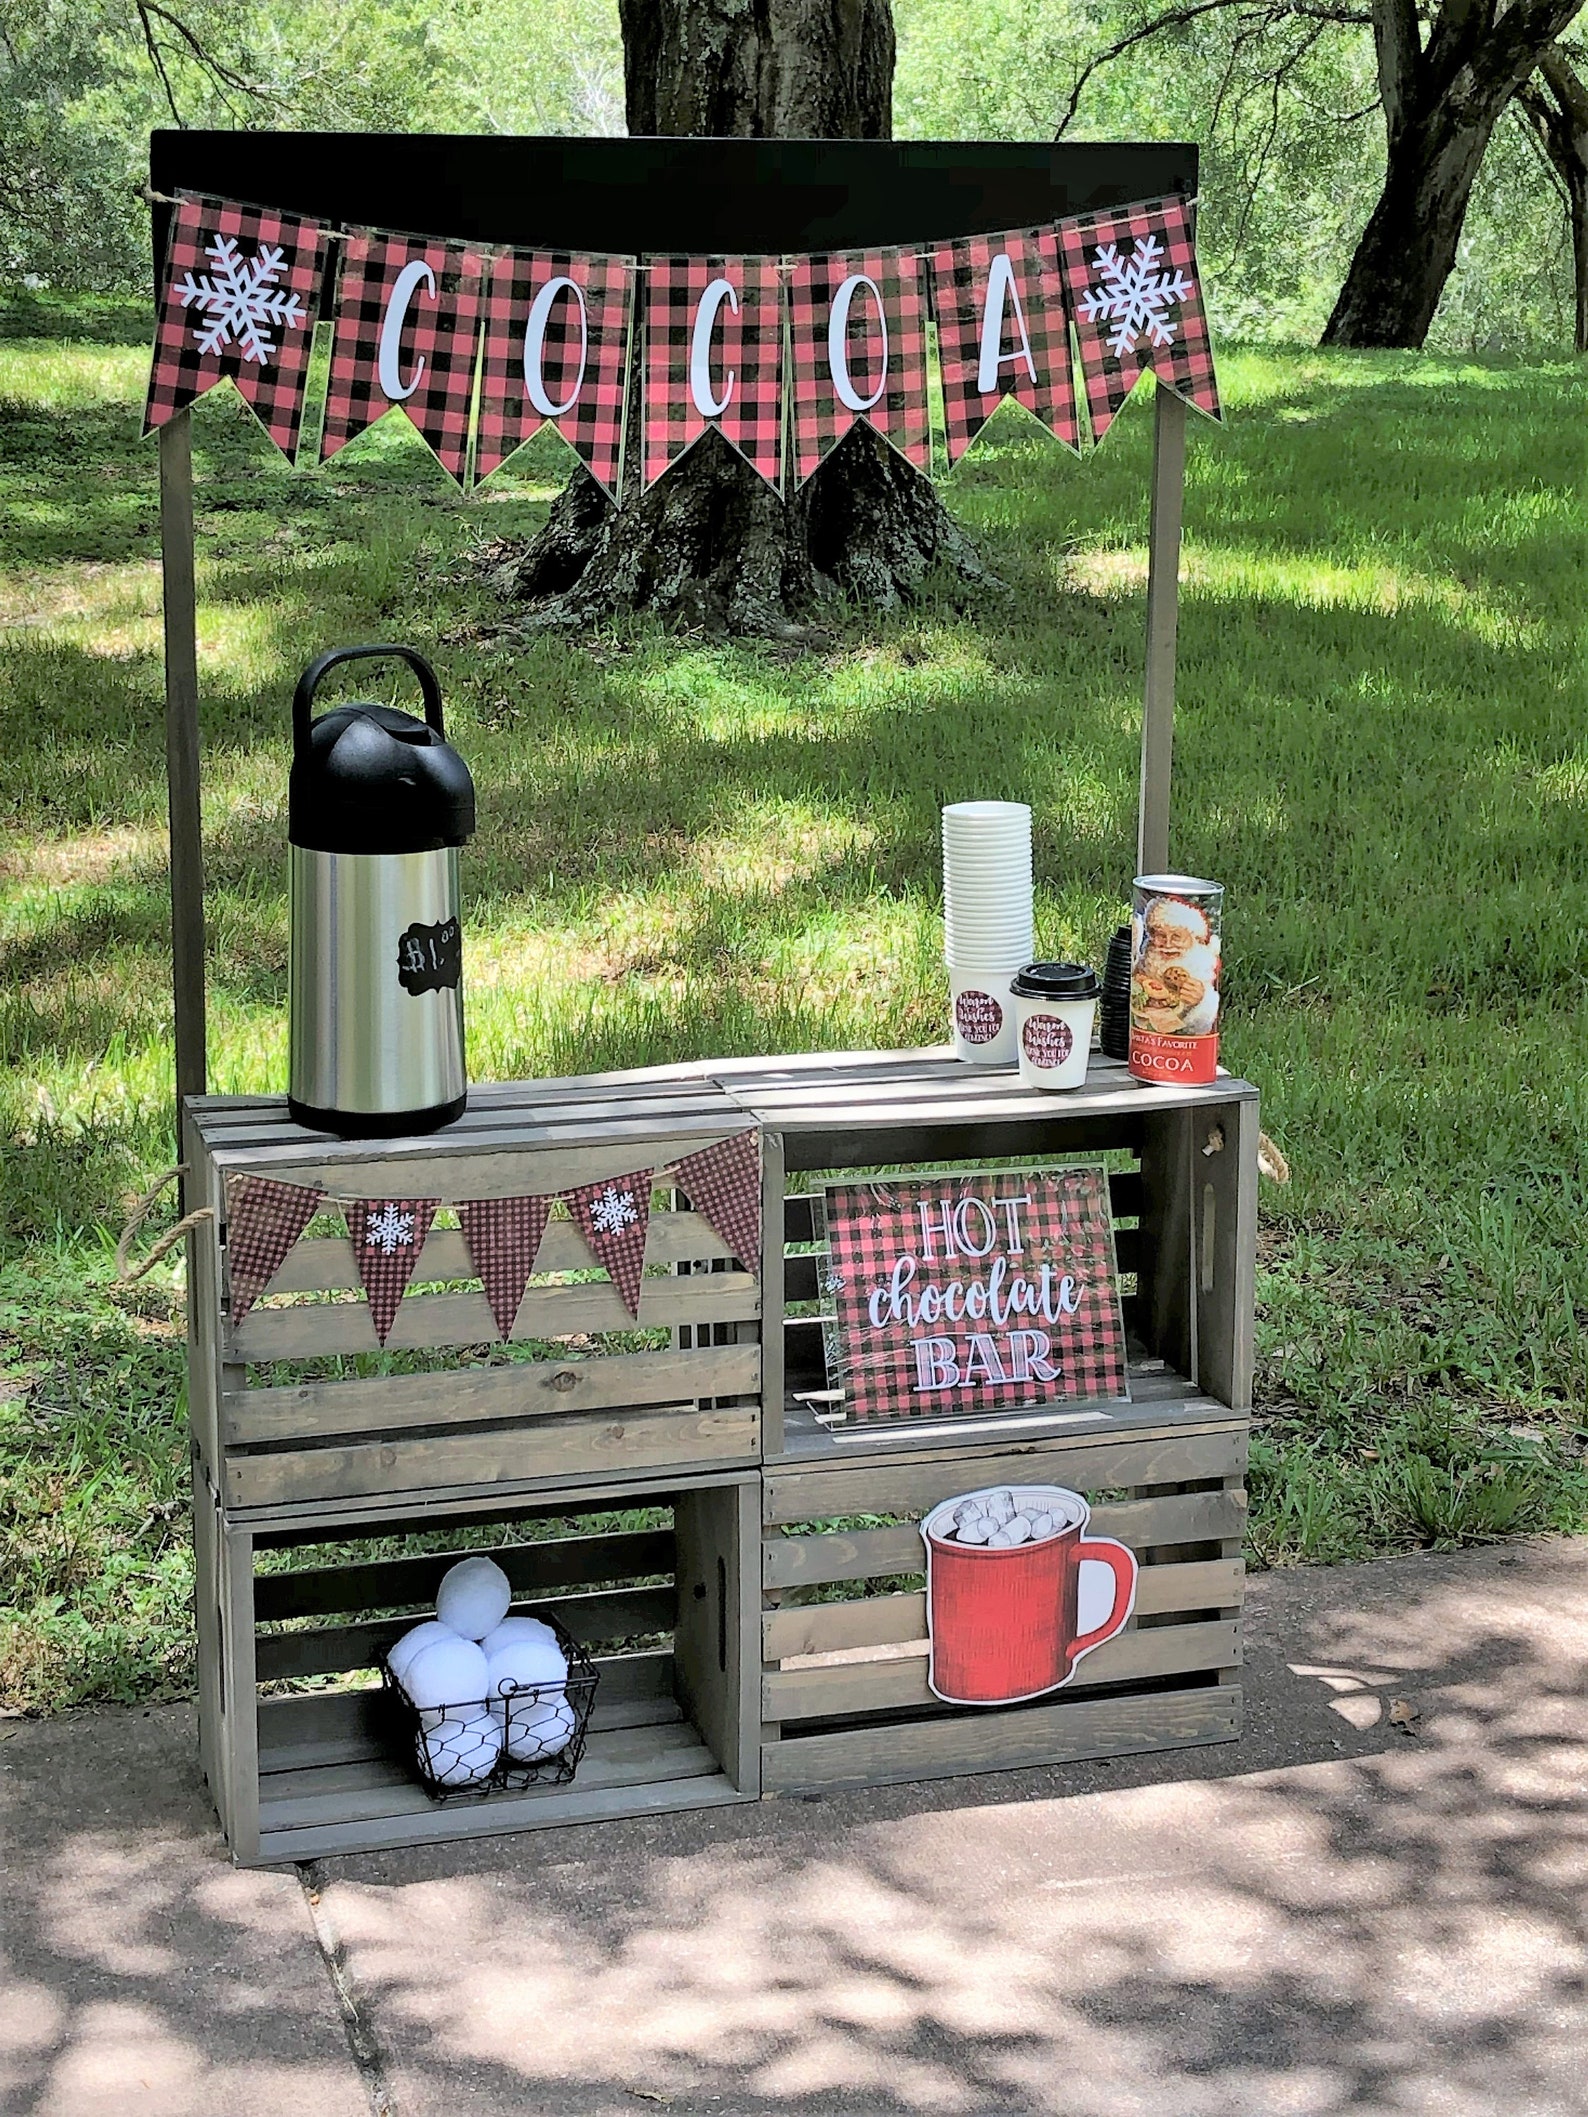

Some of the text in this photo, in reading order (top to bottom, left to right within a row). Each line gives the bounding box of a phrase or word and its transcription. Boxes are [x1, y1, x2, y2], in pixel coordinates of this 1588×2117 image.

[378, 254, 1038, 416] COCOA
[1132, 1050, 1194, 1072] COCOA
[917, 1193, 1032, 1261] HOT
[868, 1256, 1084, 1329] chocolate
[910, 1330, 1062, 1392] BAR
